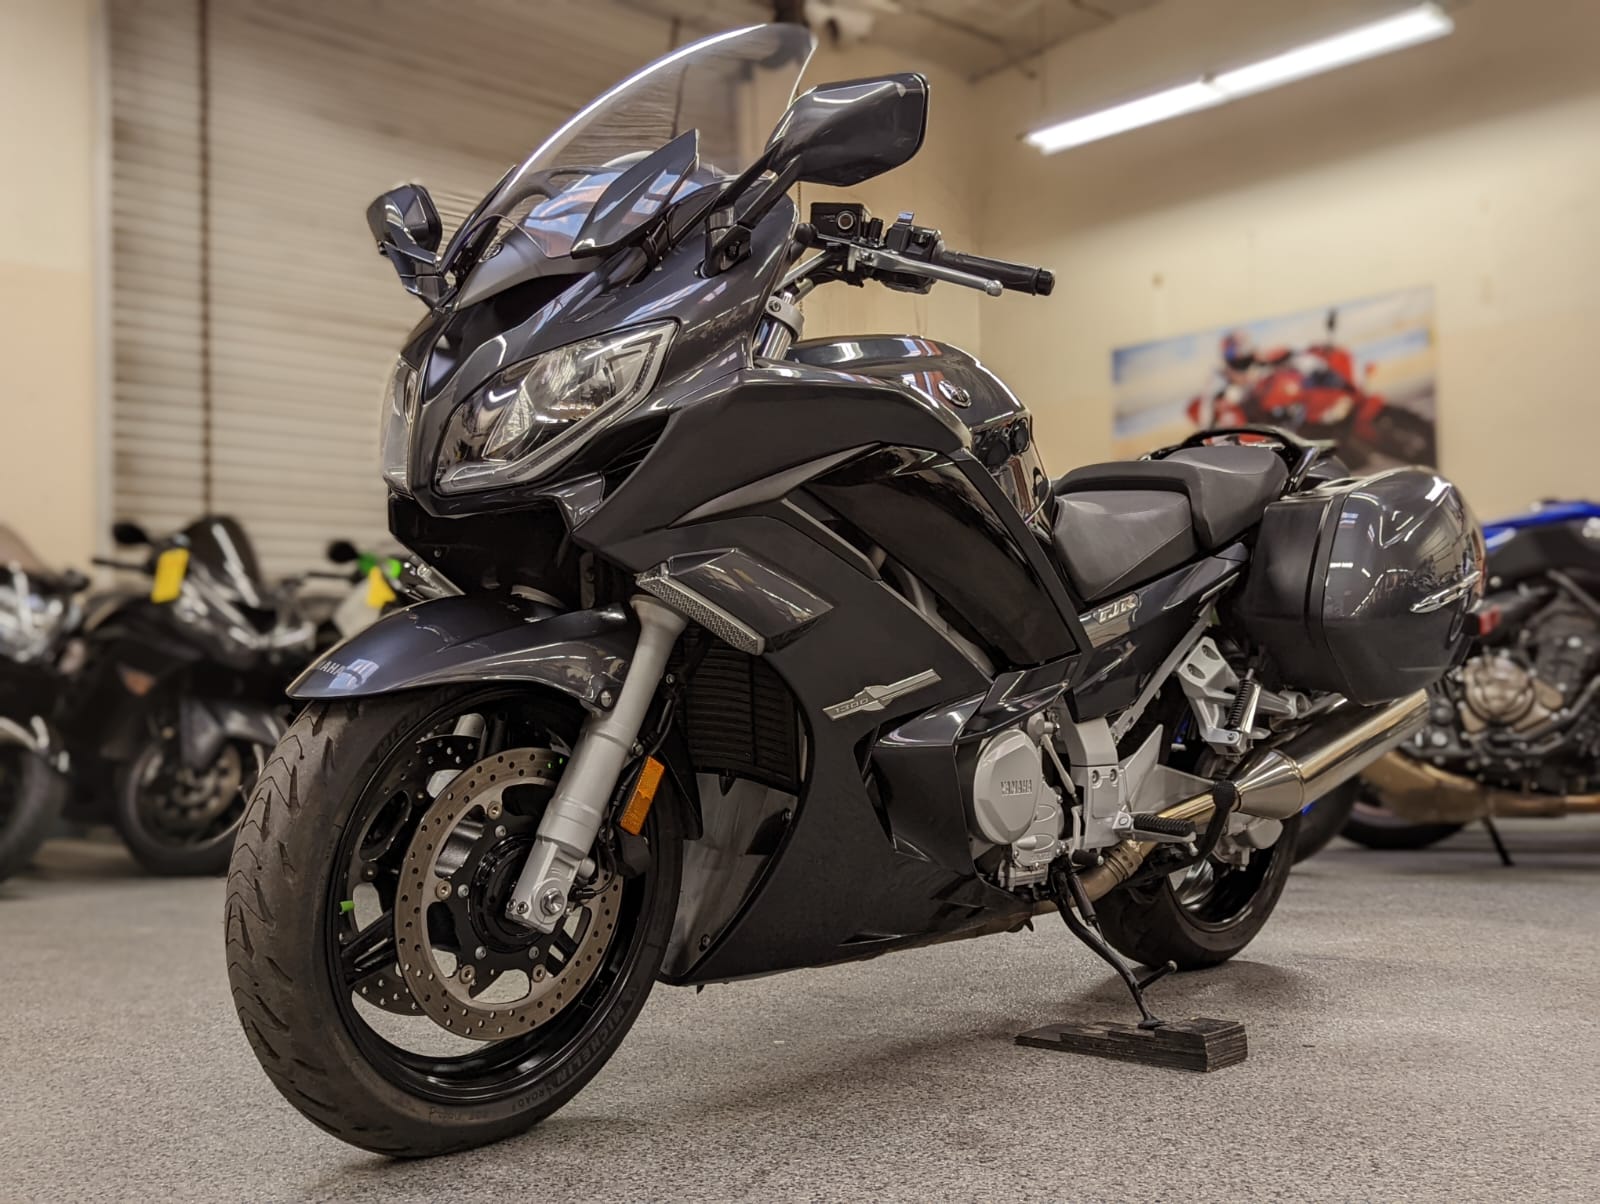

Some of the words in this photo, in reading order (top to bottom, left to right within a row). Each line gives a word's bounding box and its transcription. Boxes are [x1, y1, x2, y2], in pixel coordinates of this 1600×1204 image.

[1098, 596, 1137, 623] FJR
[834, 697, 869, 713] 1300
[1000, 779, 1033, 795] YAMAHA
[555, 1005, 625, 1085] MICHELIN
